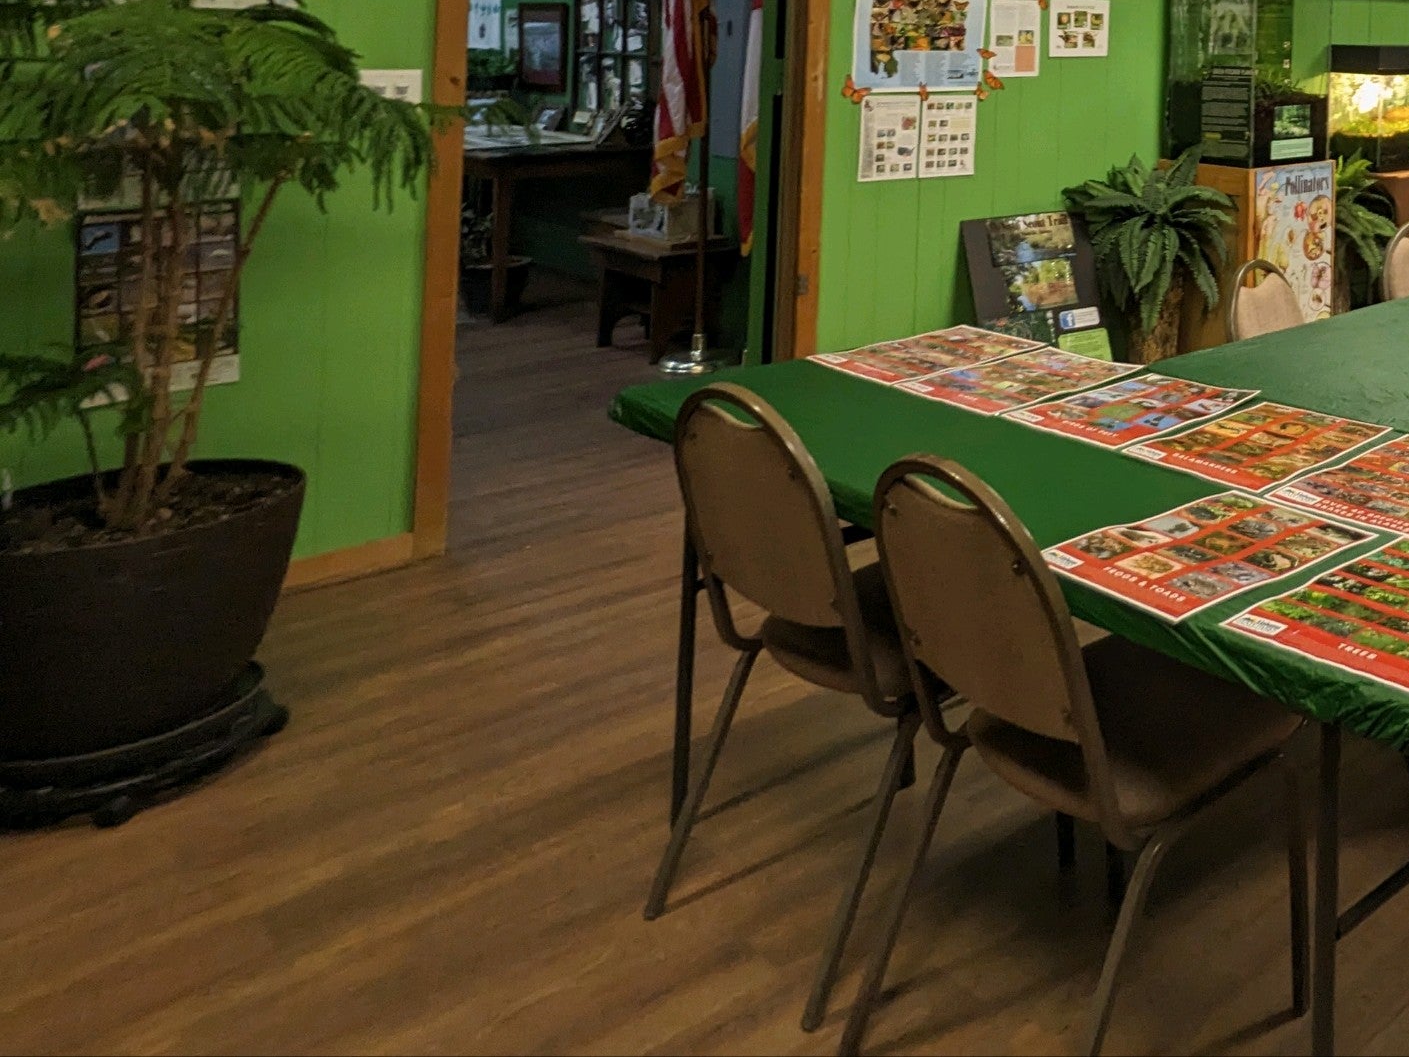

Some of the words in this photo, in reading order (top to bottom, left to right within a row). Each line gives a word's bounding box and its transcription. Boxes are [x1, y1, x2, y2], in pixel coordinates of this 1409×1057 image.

[1284, 174, 1329, 197] Pollinators
[1171, 452, 1238, 474] SALAMANDERS
[1314, 502, 1354, 517] SNAKES
[1355, 514, 1368, 522] IN
[1321, 499, 1349, 510] OVER
[1102, 565, 1138, 583] FROGS
[1138, 579, 1148, 588] &
[1149, 583, 1188, 603] TOADS
[1337, 642, 1378, 661] TREES
